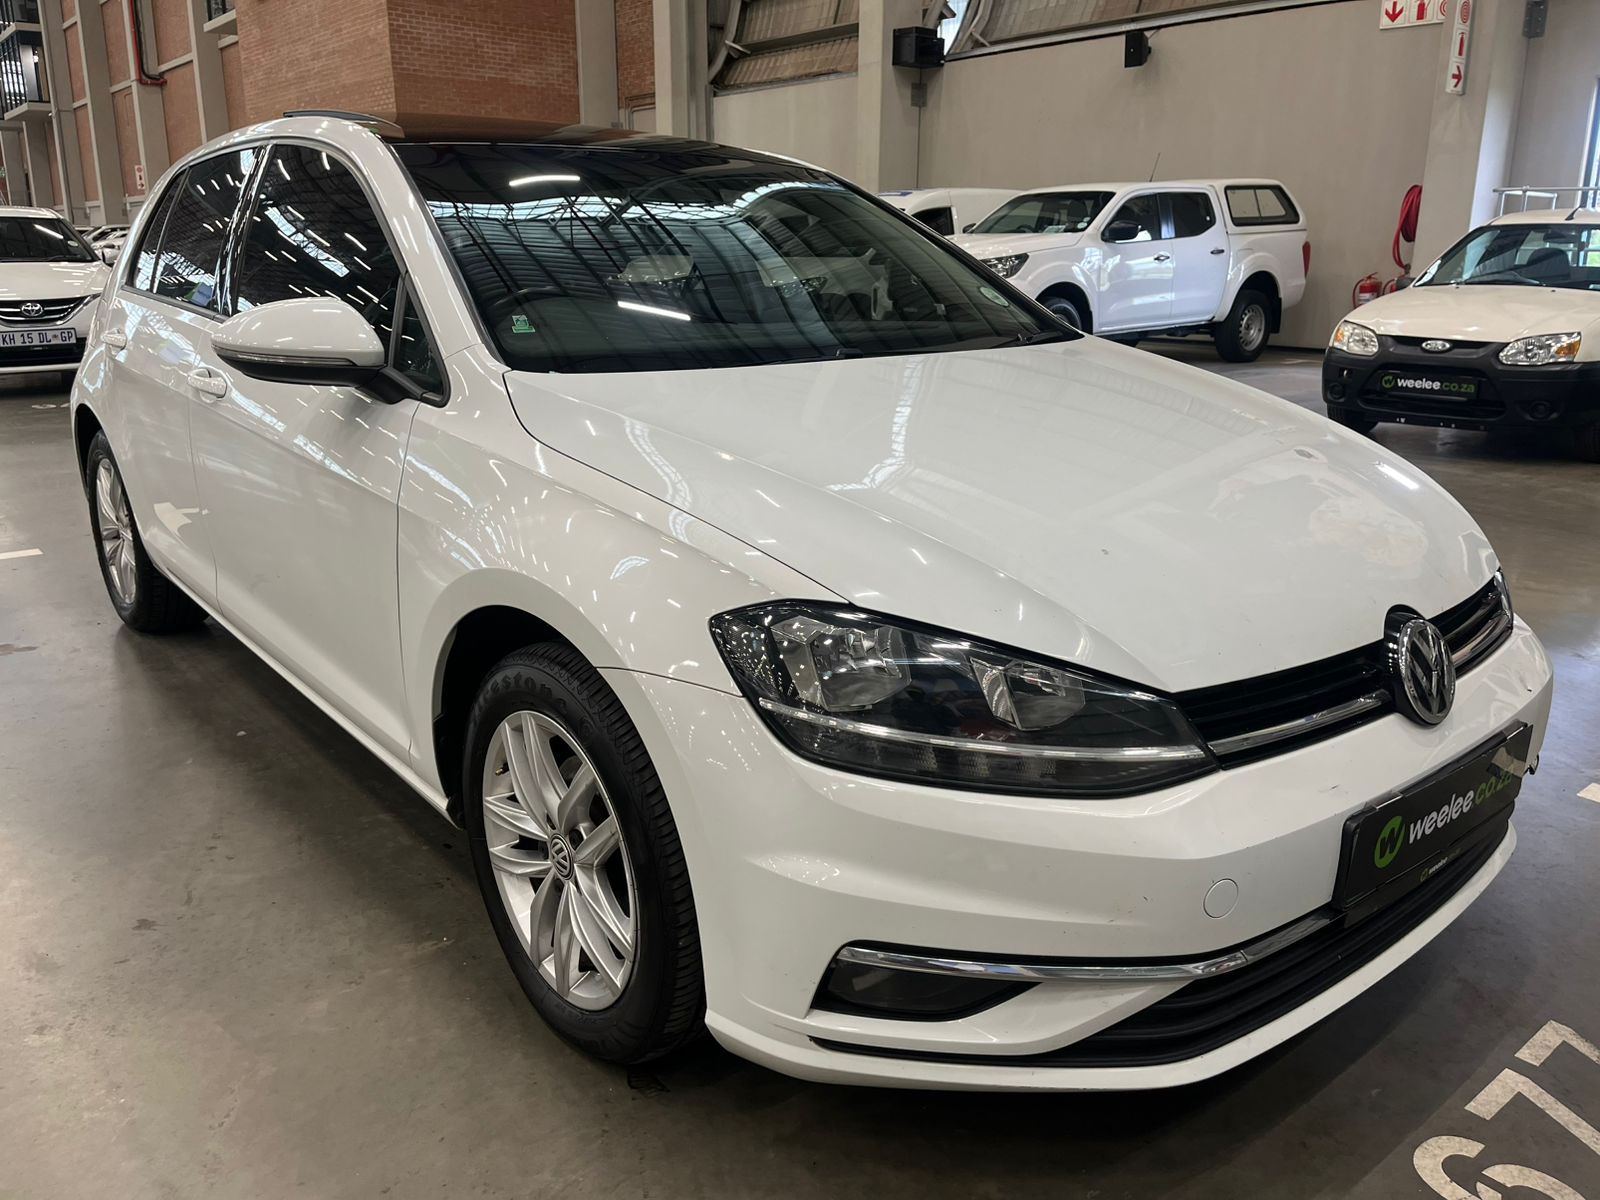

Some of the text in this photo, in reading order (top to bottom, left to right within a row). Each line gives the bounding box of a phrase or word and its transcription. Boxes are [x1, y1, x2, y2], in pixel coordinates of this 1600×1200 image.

[1, 331, 73, 345] KH 15 DL GP
